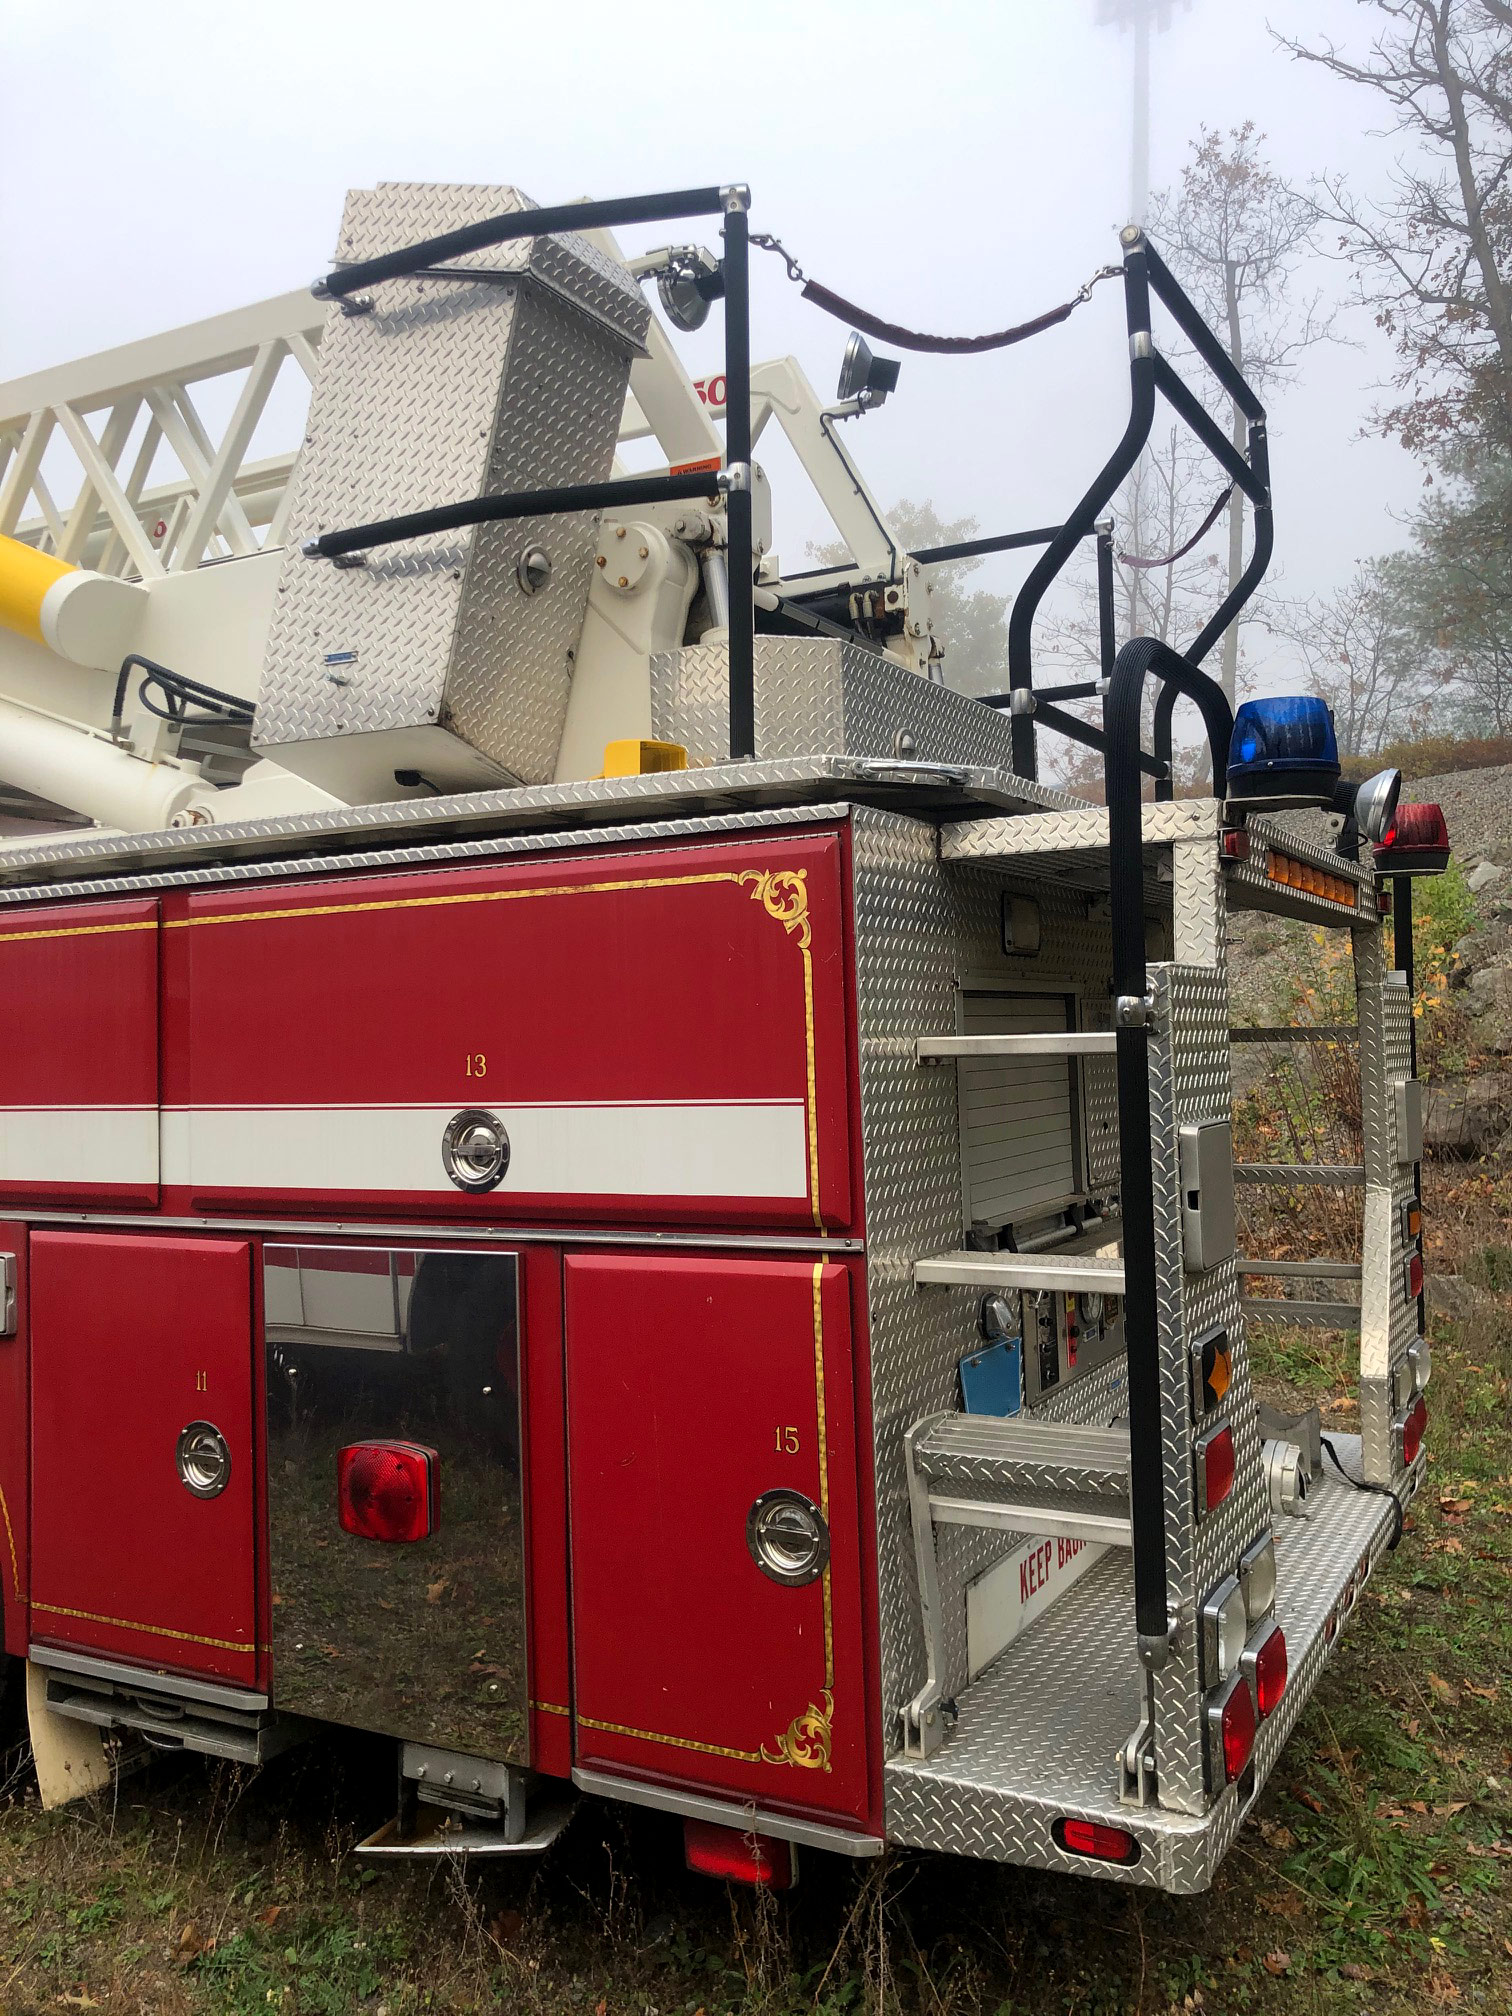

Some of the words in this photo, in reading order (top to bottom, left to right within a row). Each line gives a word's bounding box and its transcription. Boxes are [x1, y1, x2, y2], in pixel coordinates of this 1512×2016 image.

[466, 1053, 487, 1078] 13
[196, 1370, 208, 1392] 11
[775, 1426, 800, 1454] 15
[1020, 1540, 1052, 1604] KEEP
[1057, 1537, 1087, 1570] BA
